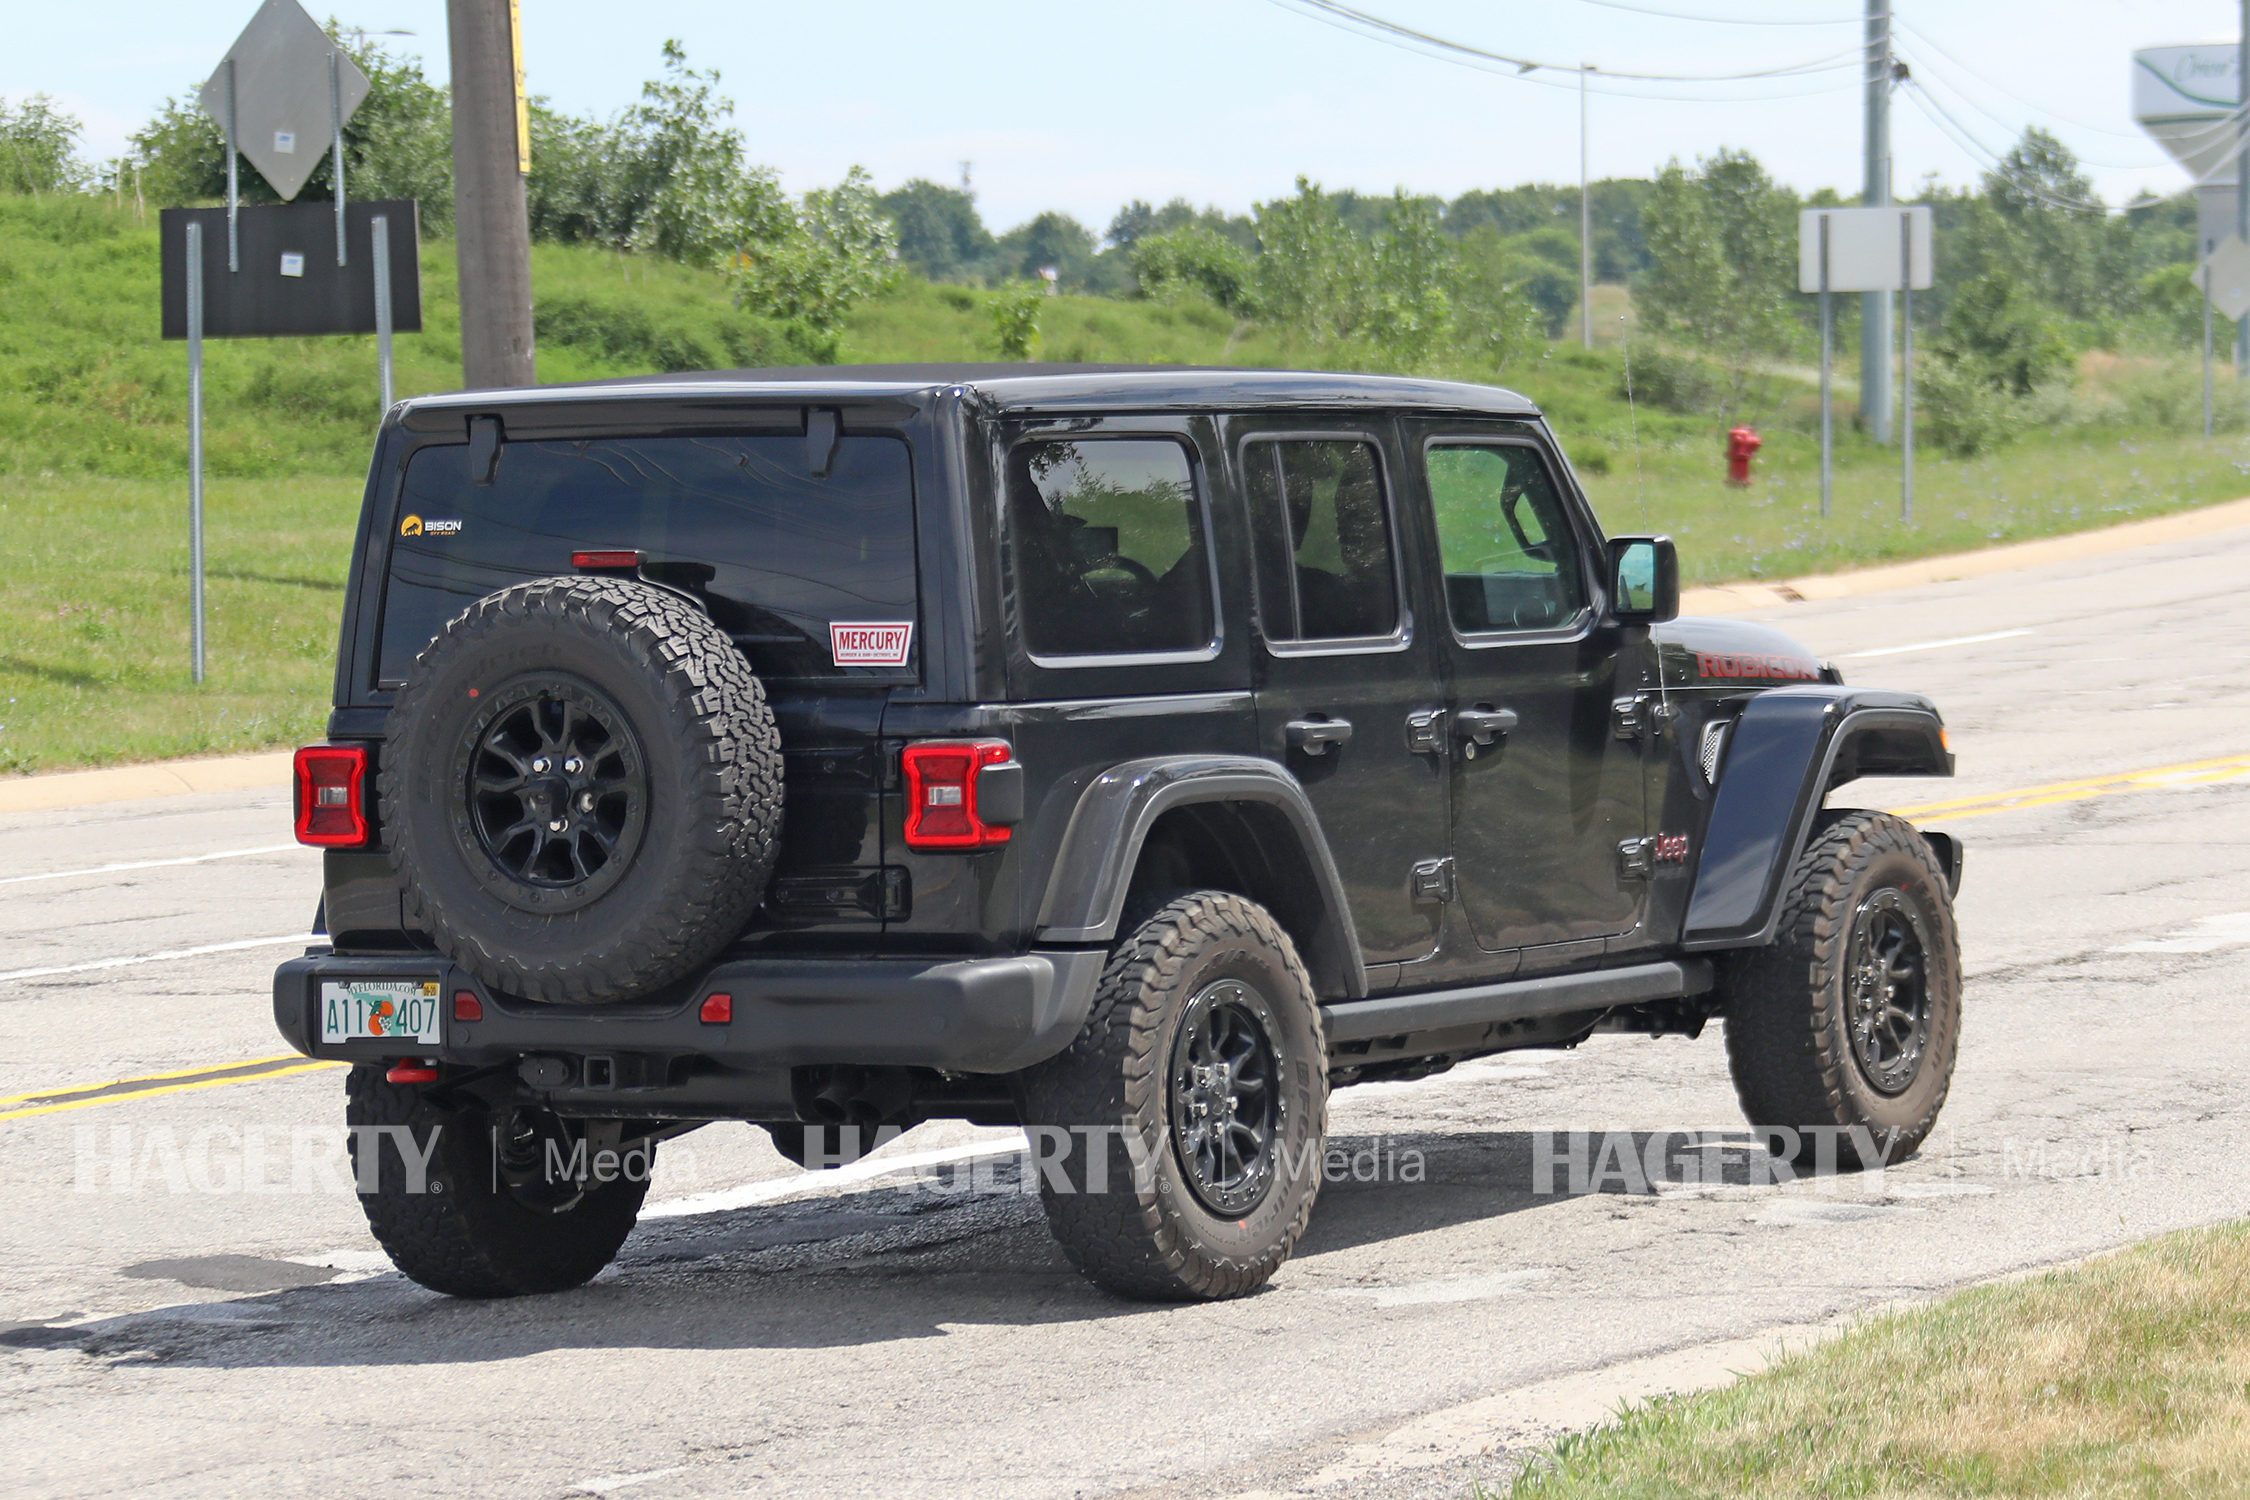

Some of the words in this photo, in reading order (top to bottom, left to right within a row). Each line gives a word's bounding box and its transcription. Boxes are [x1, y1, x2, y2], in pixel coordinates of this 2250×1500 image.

[425, 521, 462, 531] BISON
[839, 631, 903, 650] MERCURY
[1696, 653, 1819, 681] RUBICON
[1653, 832, 1688, 863] Jeep
